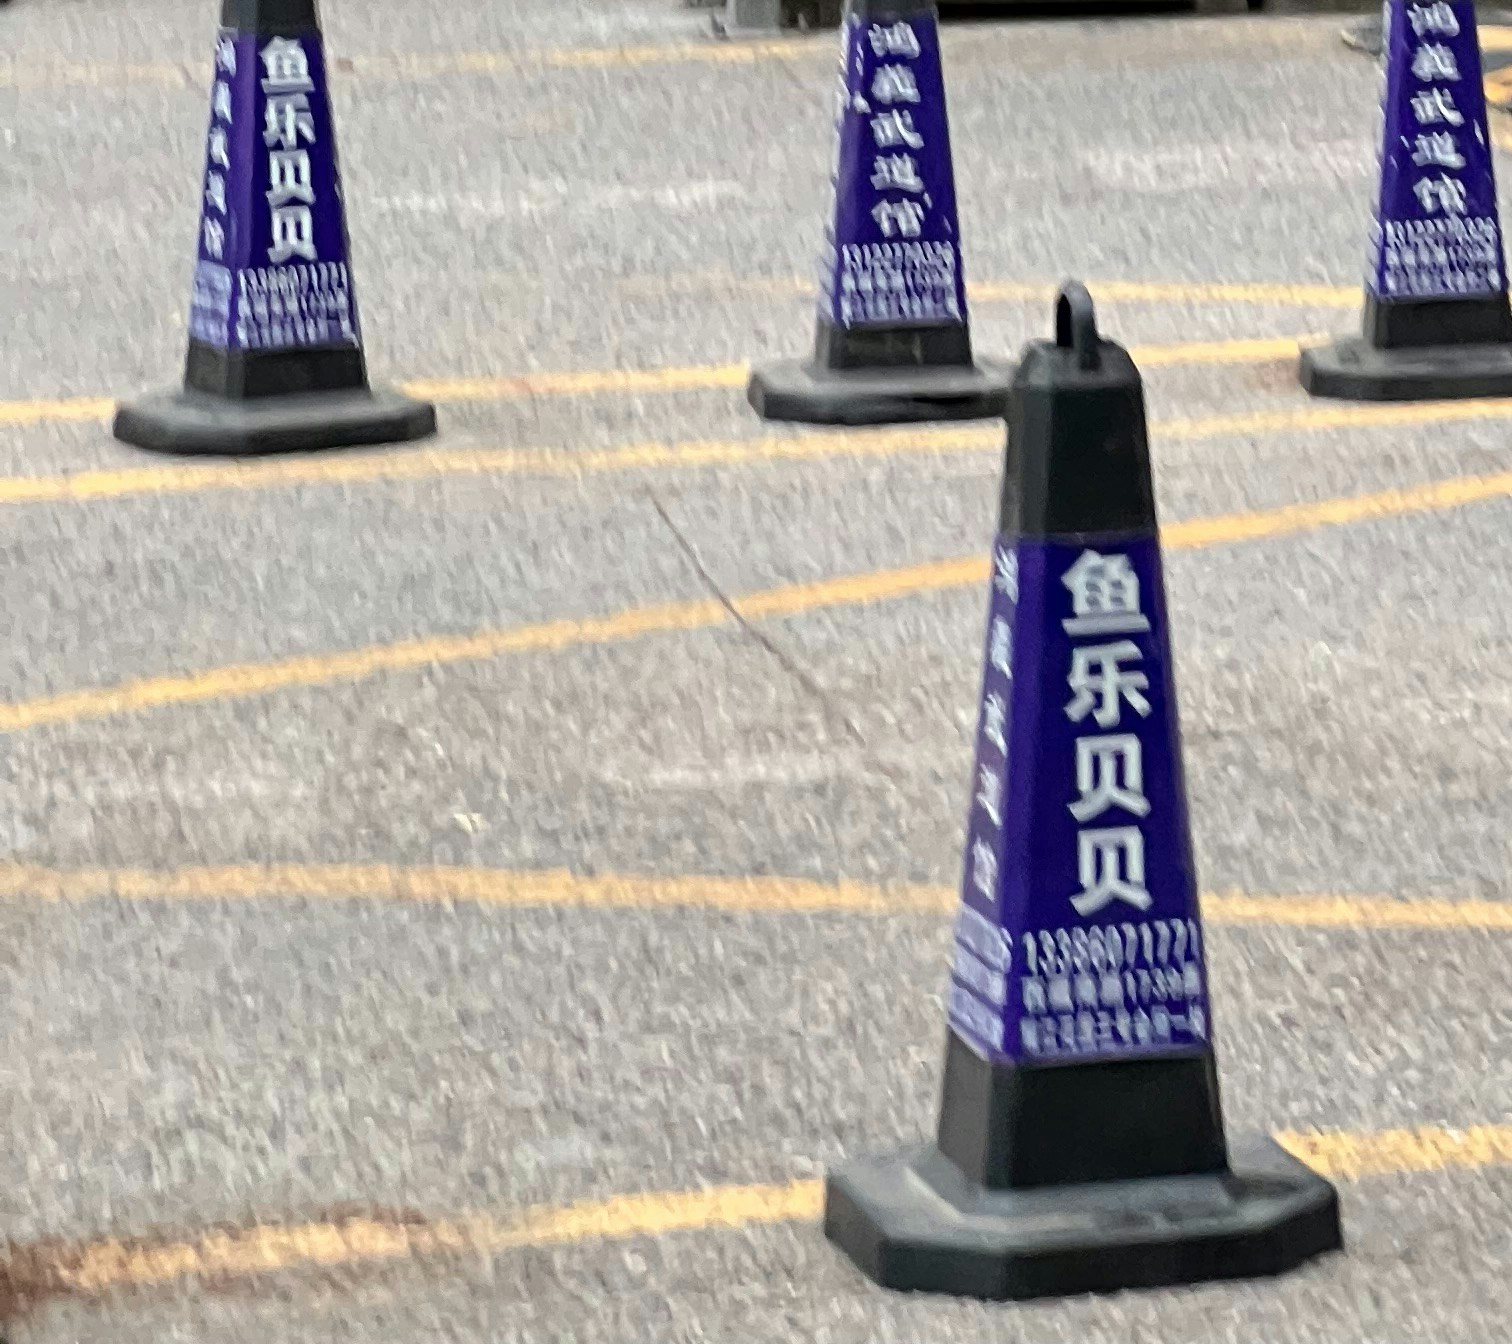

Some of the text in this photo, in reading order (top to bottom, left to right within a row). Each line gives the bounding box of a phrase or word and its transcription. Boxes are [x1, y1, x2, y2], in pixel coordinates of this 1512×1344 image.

[260, 34, 316, 264] 鱼乐贝贝
[1061, 548, 1152, 917] 鱼乐贝贝
